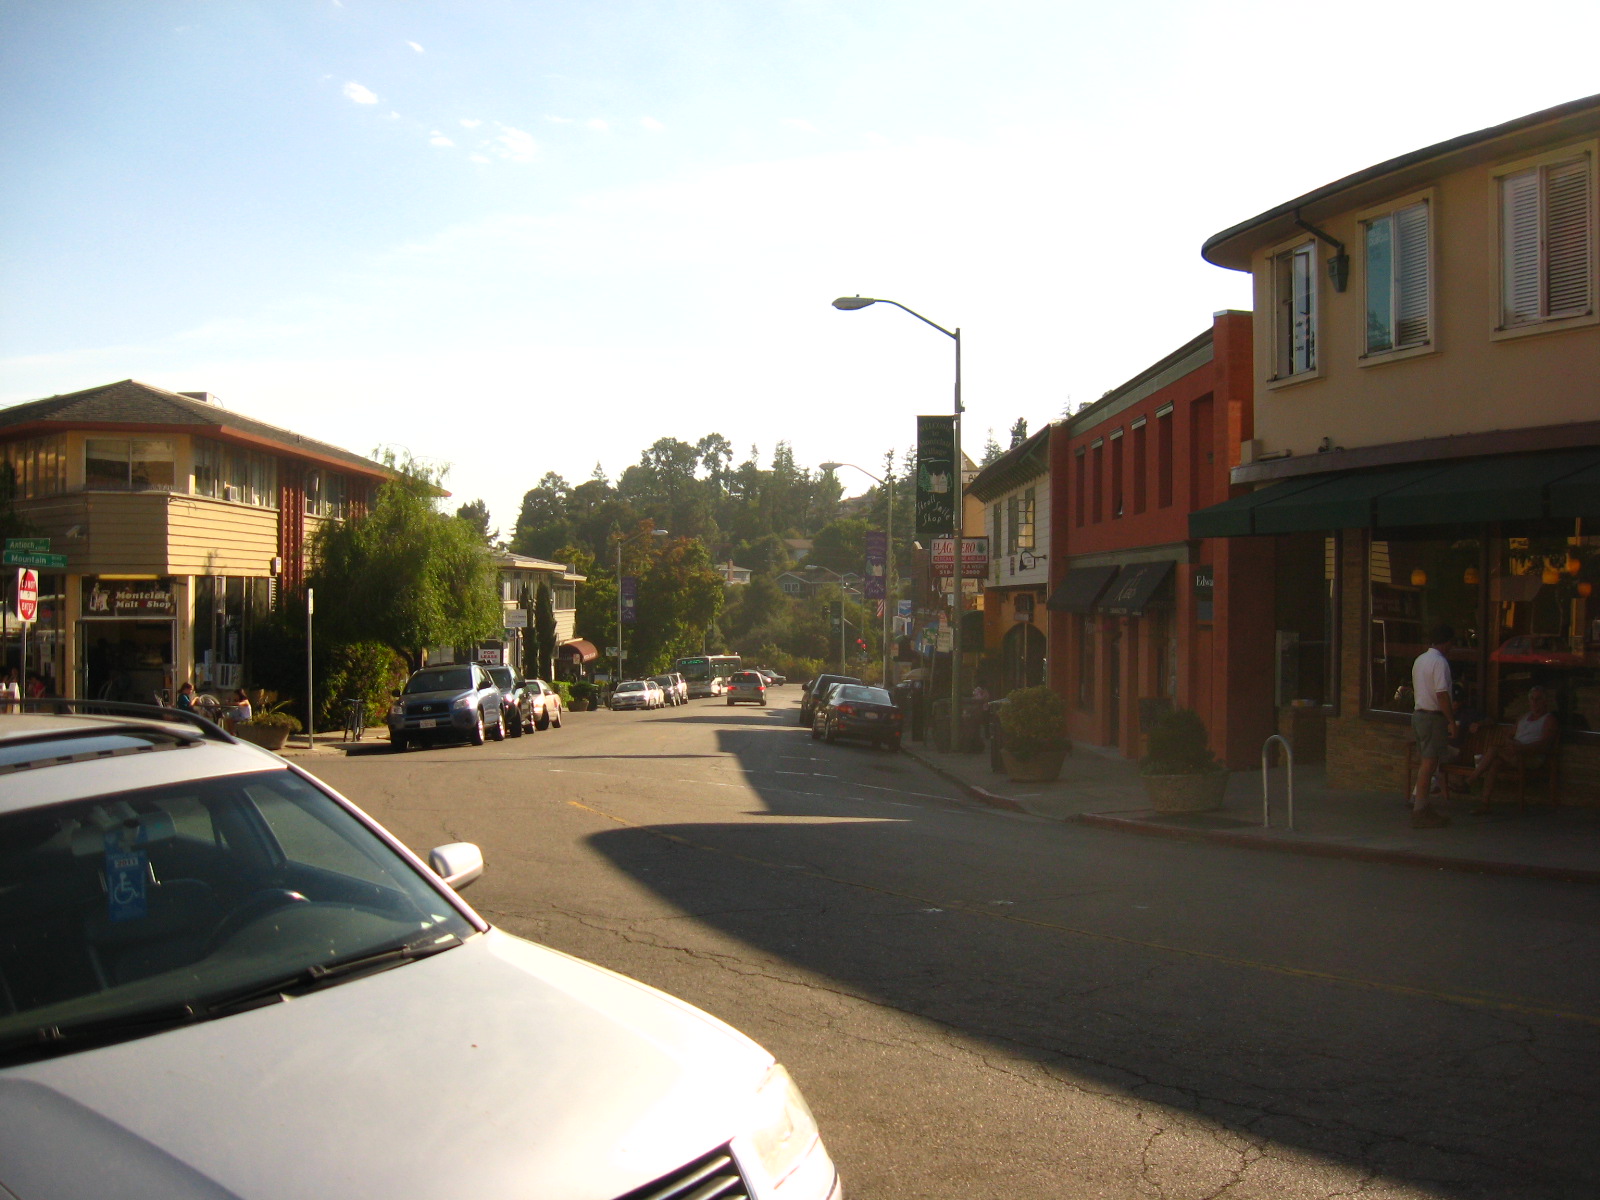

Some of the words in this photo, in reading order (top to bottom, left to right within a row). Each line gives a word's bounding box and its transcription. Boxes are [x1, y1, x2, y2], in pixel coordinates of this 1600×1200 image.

[922, 512, 942, 527] Shop
[10, 540, 35, 549] Antioch
[11, 554, 47, 565] Mountain
[115, 591, 171, 602] Montclair
[21, 602, 35, 611] ENTER
[115, 600, 138, 608] Malt
[146, 600, 171, 609] Shop
